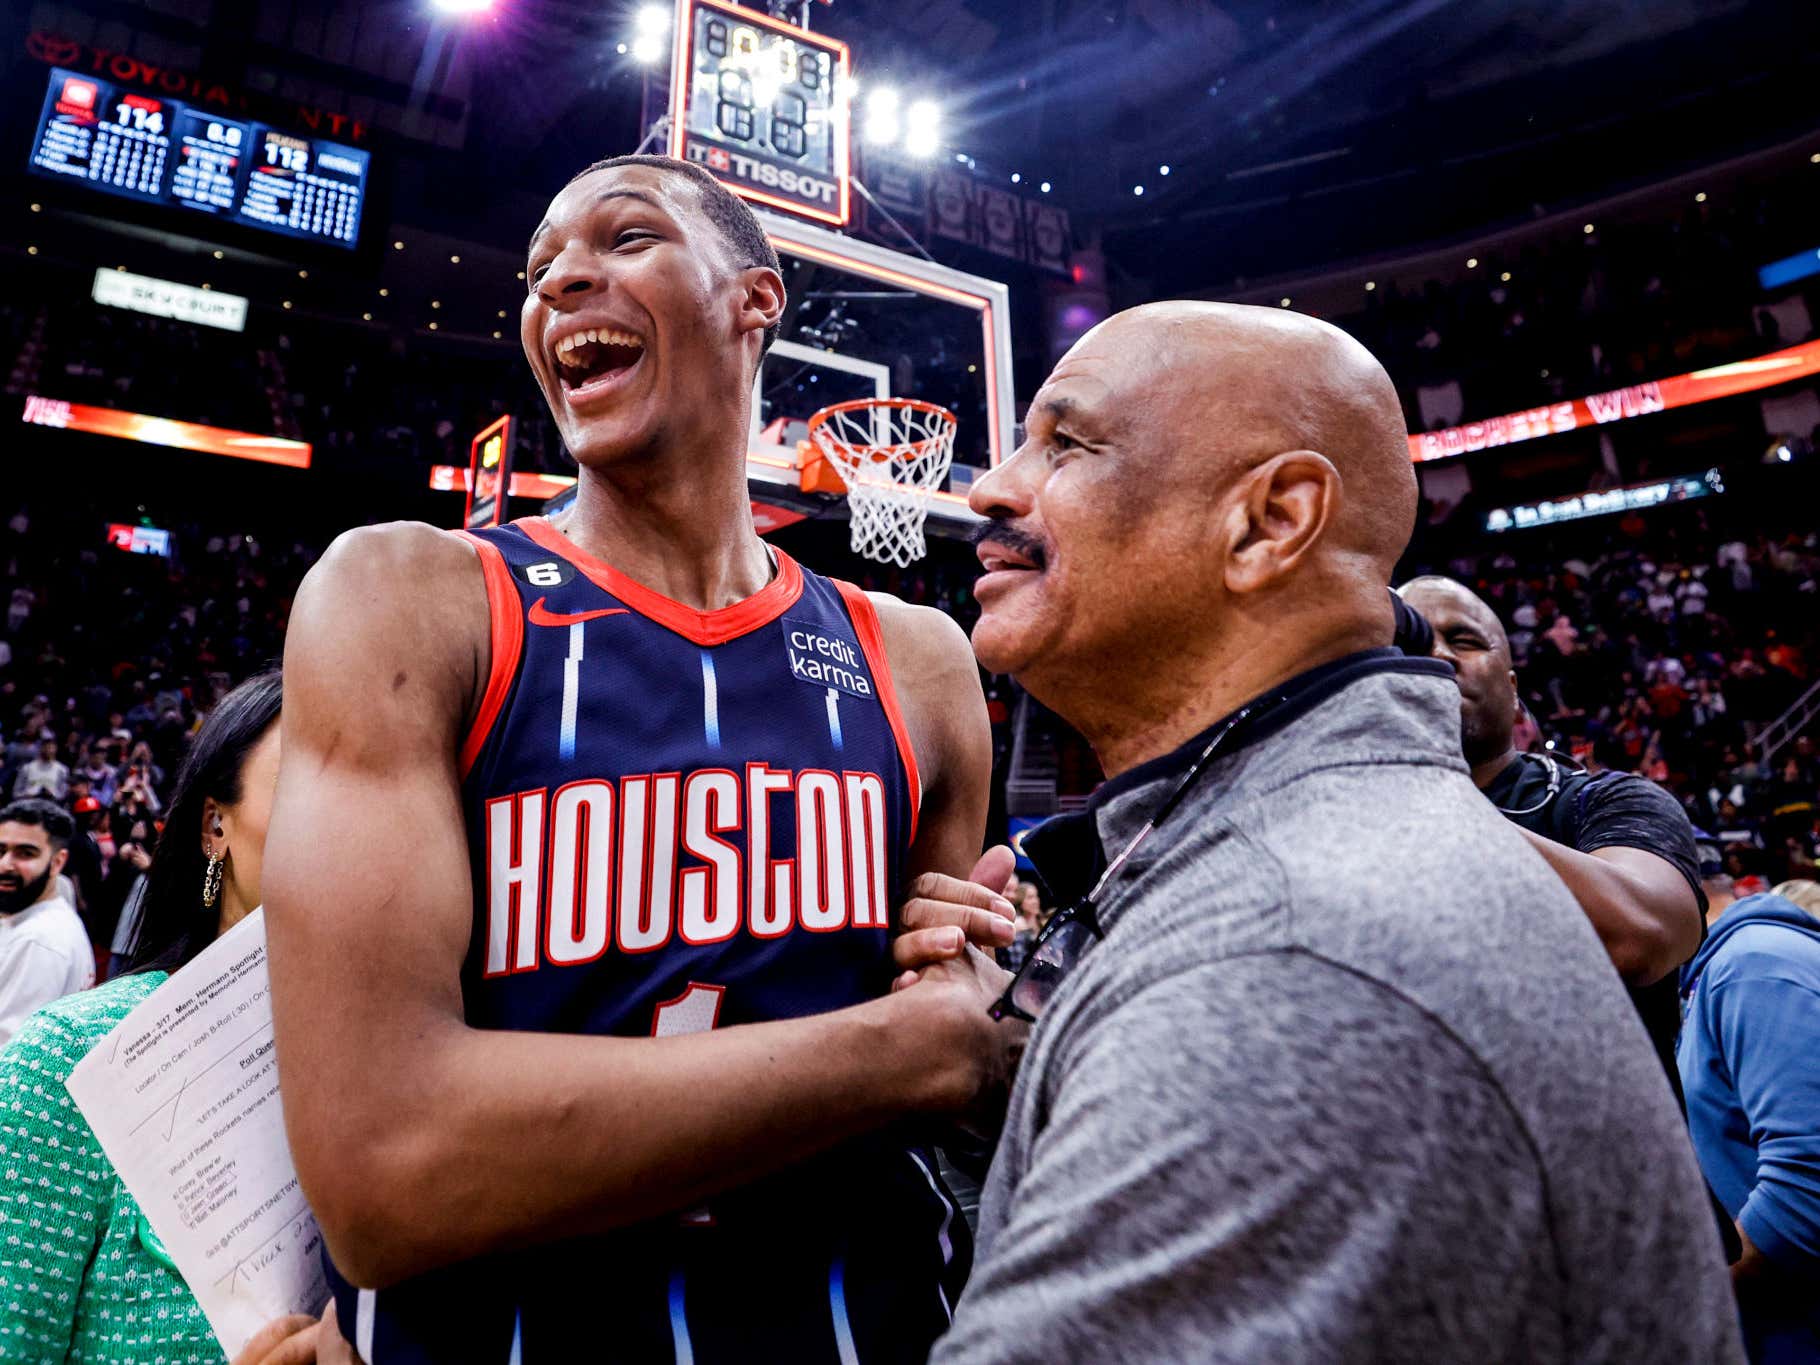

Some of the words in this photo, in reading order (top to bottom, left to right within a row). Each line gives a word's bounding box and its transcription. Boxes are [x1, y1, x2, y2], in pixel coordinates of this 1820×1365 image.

[116, 103, 164, 134] 114
[730, 155, 838, 202] TISSOT
[1420, 401, 1577, 461] ROCKETS
[1585, 381, 1666, 424] WIN
[525, 563, 562, 587] 6
[790, 627, 860, 669] credit
[789, 647, 871, 695] karma
[196, 972, 229, 998] Hermann
[230, 947, 263, 974] Spotlight
[209, 977, 237, 999] Memorial
[238, 956, 266, 978] Hermann
[239, 1054, 255, 1068] Poll
